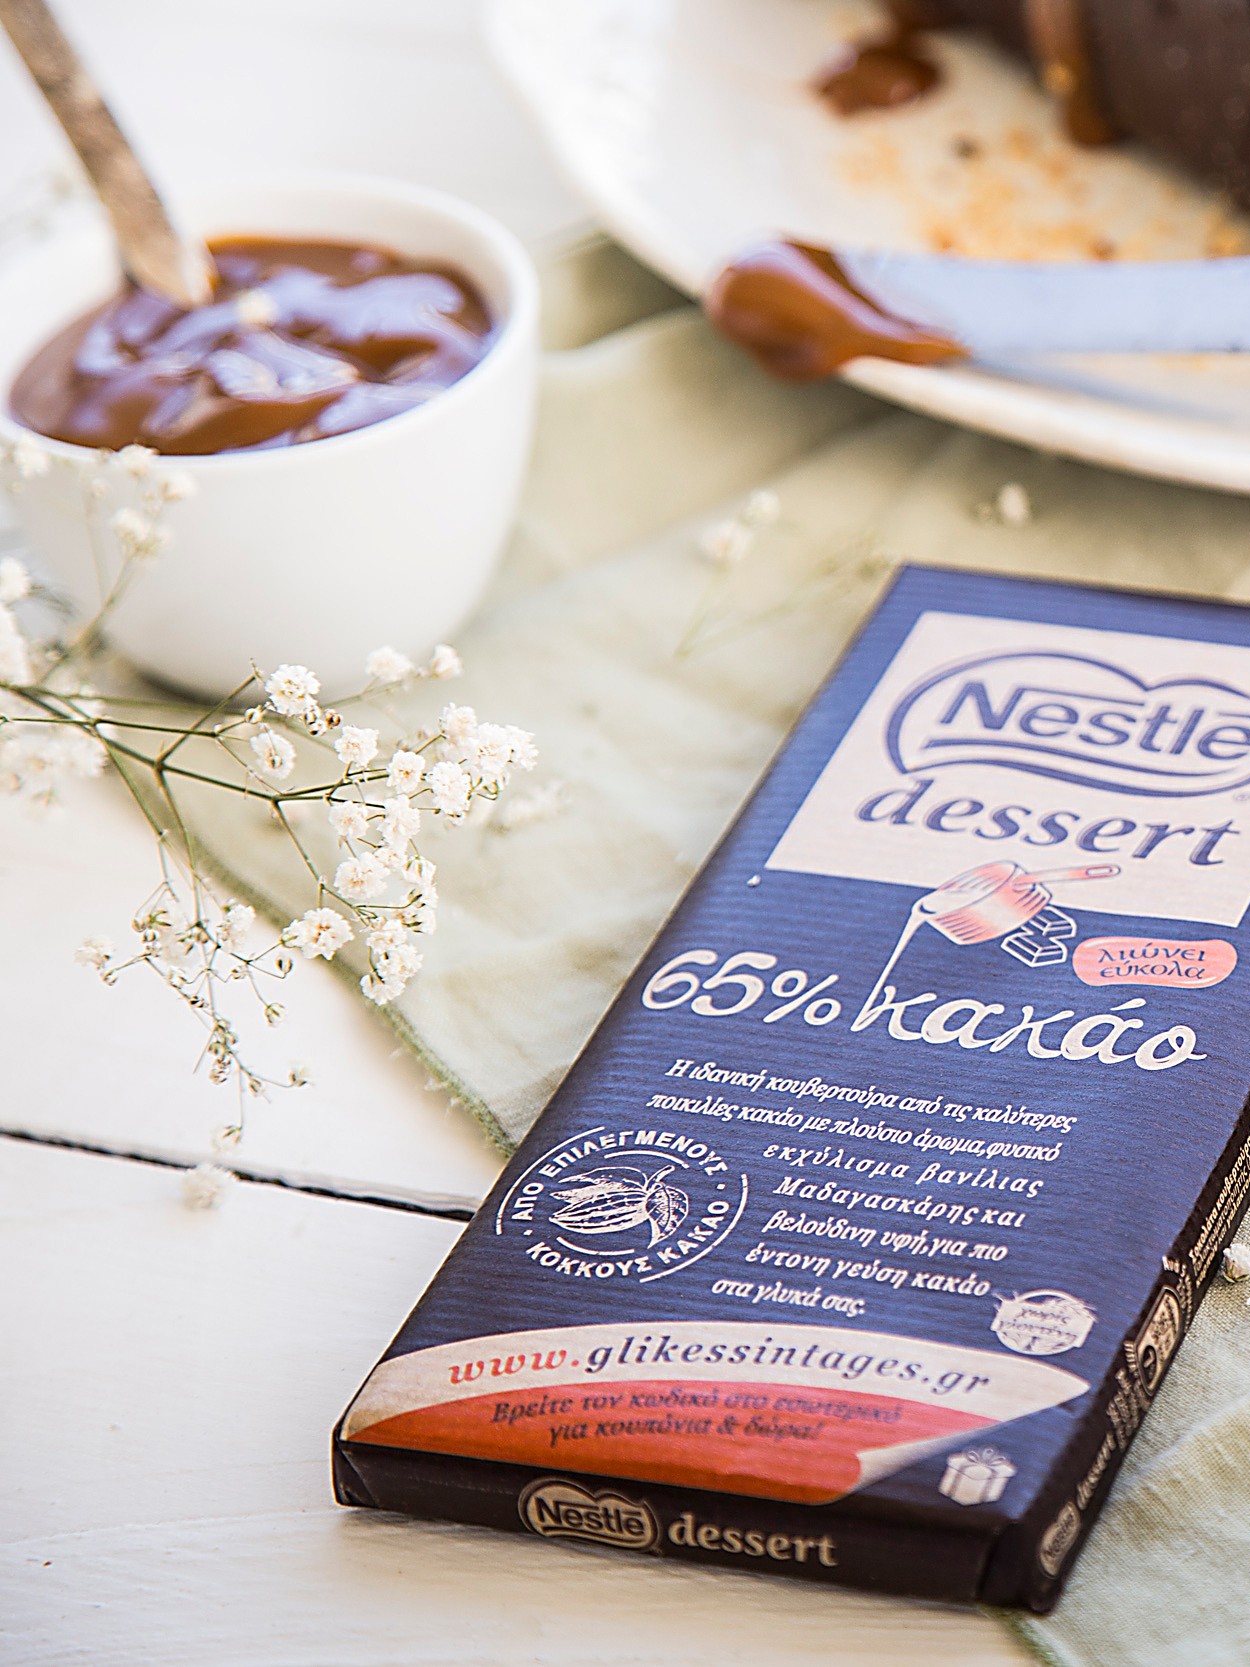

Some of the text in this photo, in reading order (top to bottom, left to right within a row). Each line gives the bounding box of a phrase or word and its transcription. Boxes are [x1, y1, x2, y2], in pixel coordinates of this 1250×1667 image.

[855, 776, 1242, 867] dessert
[1098, 940, 1208, 967] λιώνει
[1099, 957, 1208, 983] εύκολα
[642, 949, 1206, 1072] 65% κακάο
[646, 1094, 740, 1121] ποικιλίες
[737, 1106, 803, 1128] κακάο
[800, 1118, 832, 1138] με
[833, 1116, 913, 1145] πλούσιο
[691, 1061, 768, 1092] ιδανική
[766, 1075, 899, 1112] κουβερτούρα
[899, 1095, 943, 1115] από
[943, 1102, 972, 1122] τις
[972, 1104, 1078, 1133] καλύτερες
[763, 1143, 1044, 1198] εκχύλισμα βανίλιας
[773, 1176, 1027, 1228] Μαδαγασκάρης και
[525, 1241, 653, 1279] ΚΟΚΚΟΥΣ
[761, 1209, 877, 1249] βελούδινη
[971, 1242, 1009, 1262] πιο
[745, 1242, 992, 1297] έντονη γεύση κακάο
[711, 1279, 867, 1318] στα γλυκά σας.
[447, 1335, 991, 1395] www.glikessintages.gr
[550, 1419, 589, 1447] για
[716, 1414, 741, 1436] &
[668, 1512, 838, 1567] dessert
